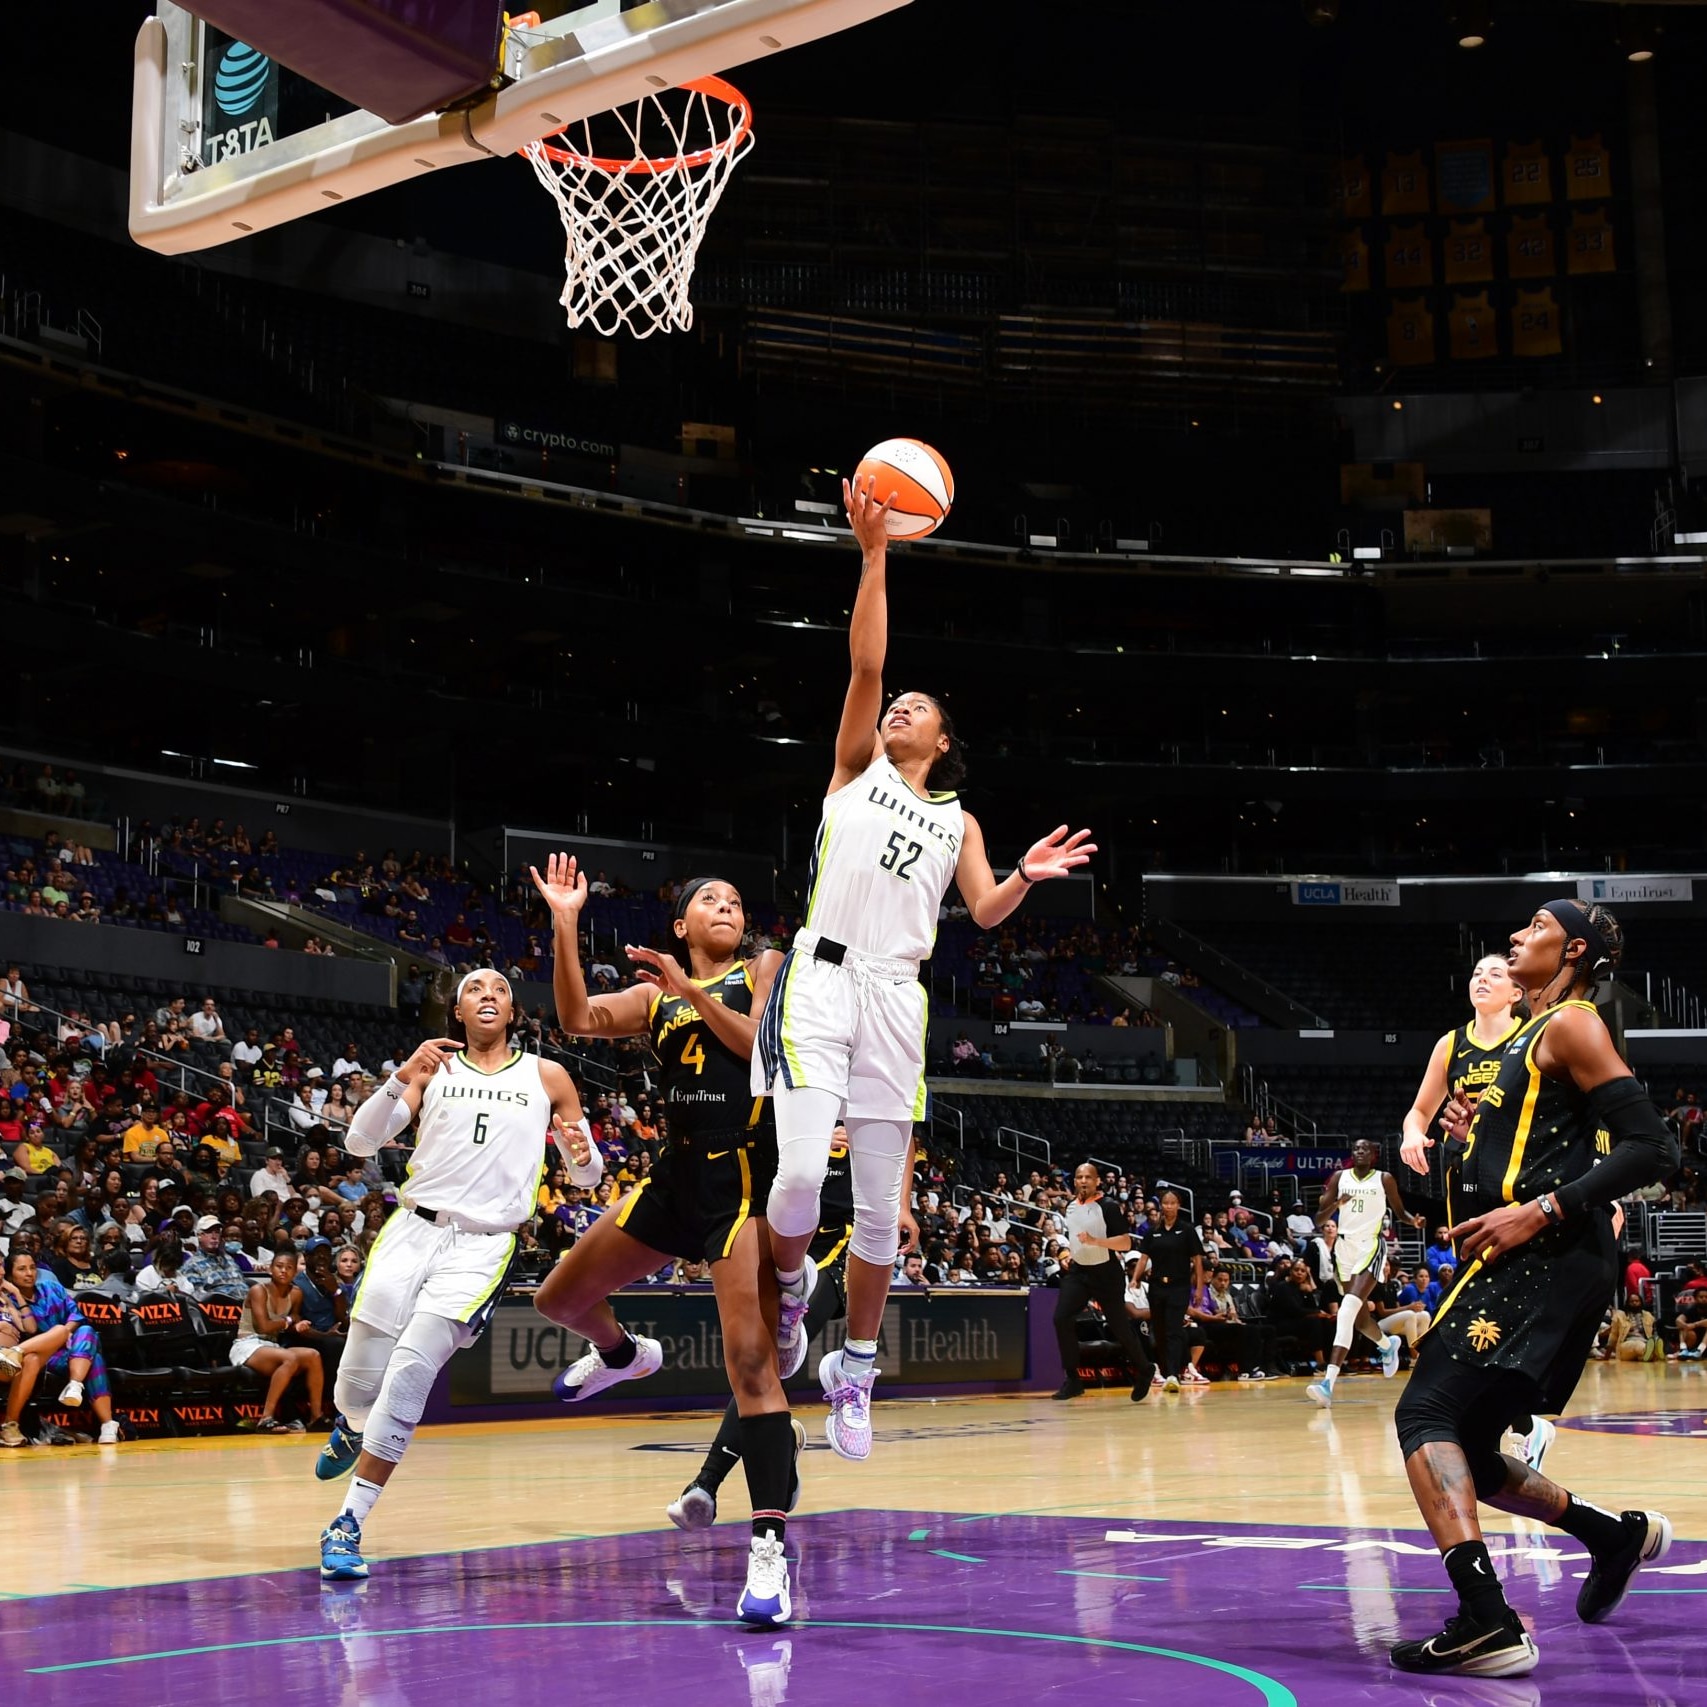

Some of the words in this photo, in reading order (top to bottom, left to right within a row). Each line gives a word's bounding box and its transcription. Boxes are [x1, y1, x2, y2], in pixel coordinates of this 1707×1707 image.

[523, 428, 614, 456] crypto.com
[868, 786, 959, 854] WINGS
[879, 831, 923, 881] 52
[1304, 888, 1335, 899] UCLA
[1344, 887, 1390, 901] Health
[1611, 886, 1675, 901] EquiTrust
[186, 940, 201, 953] 102
[994, 1024, 1008, 1035] 104
[680, 1033, 706, 1075] 4
[442, 1085, 529, 1107] WINGS
[676, 1090, 727, 1104] EquiTrust
[473, 1113, 490, 1145] 6
[1297, 1156, 1344, 1169] ULTRA
[1351, 1199, 1364, 1213] 28
[78, 1302, 123, 1319] IZZY
[130, 1302, 183, 1319] VIZZY
[510, 1327, 592, 1370] UCL
[627, 1320, 725, 1370] Healt
[908, 1318, 999, 1363] Health
[173, 1405, 224, 1420] VIZZY
[233, 1404, 265, 1419] VIZ
